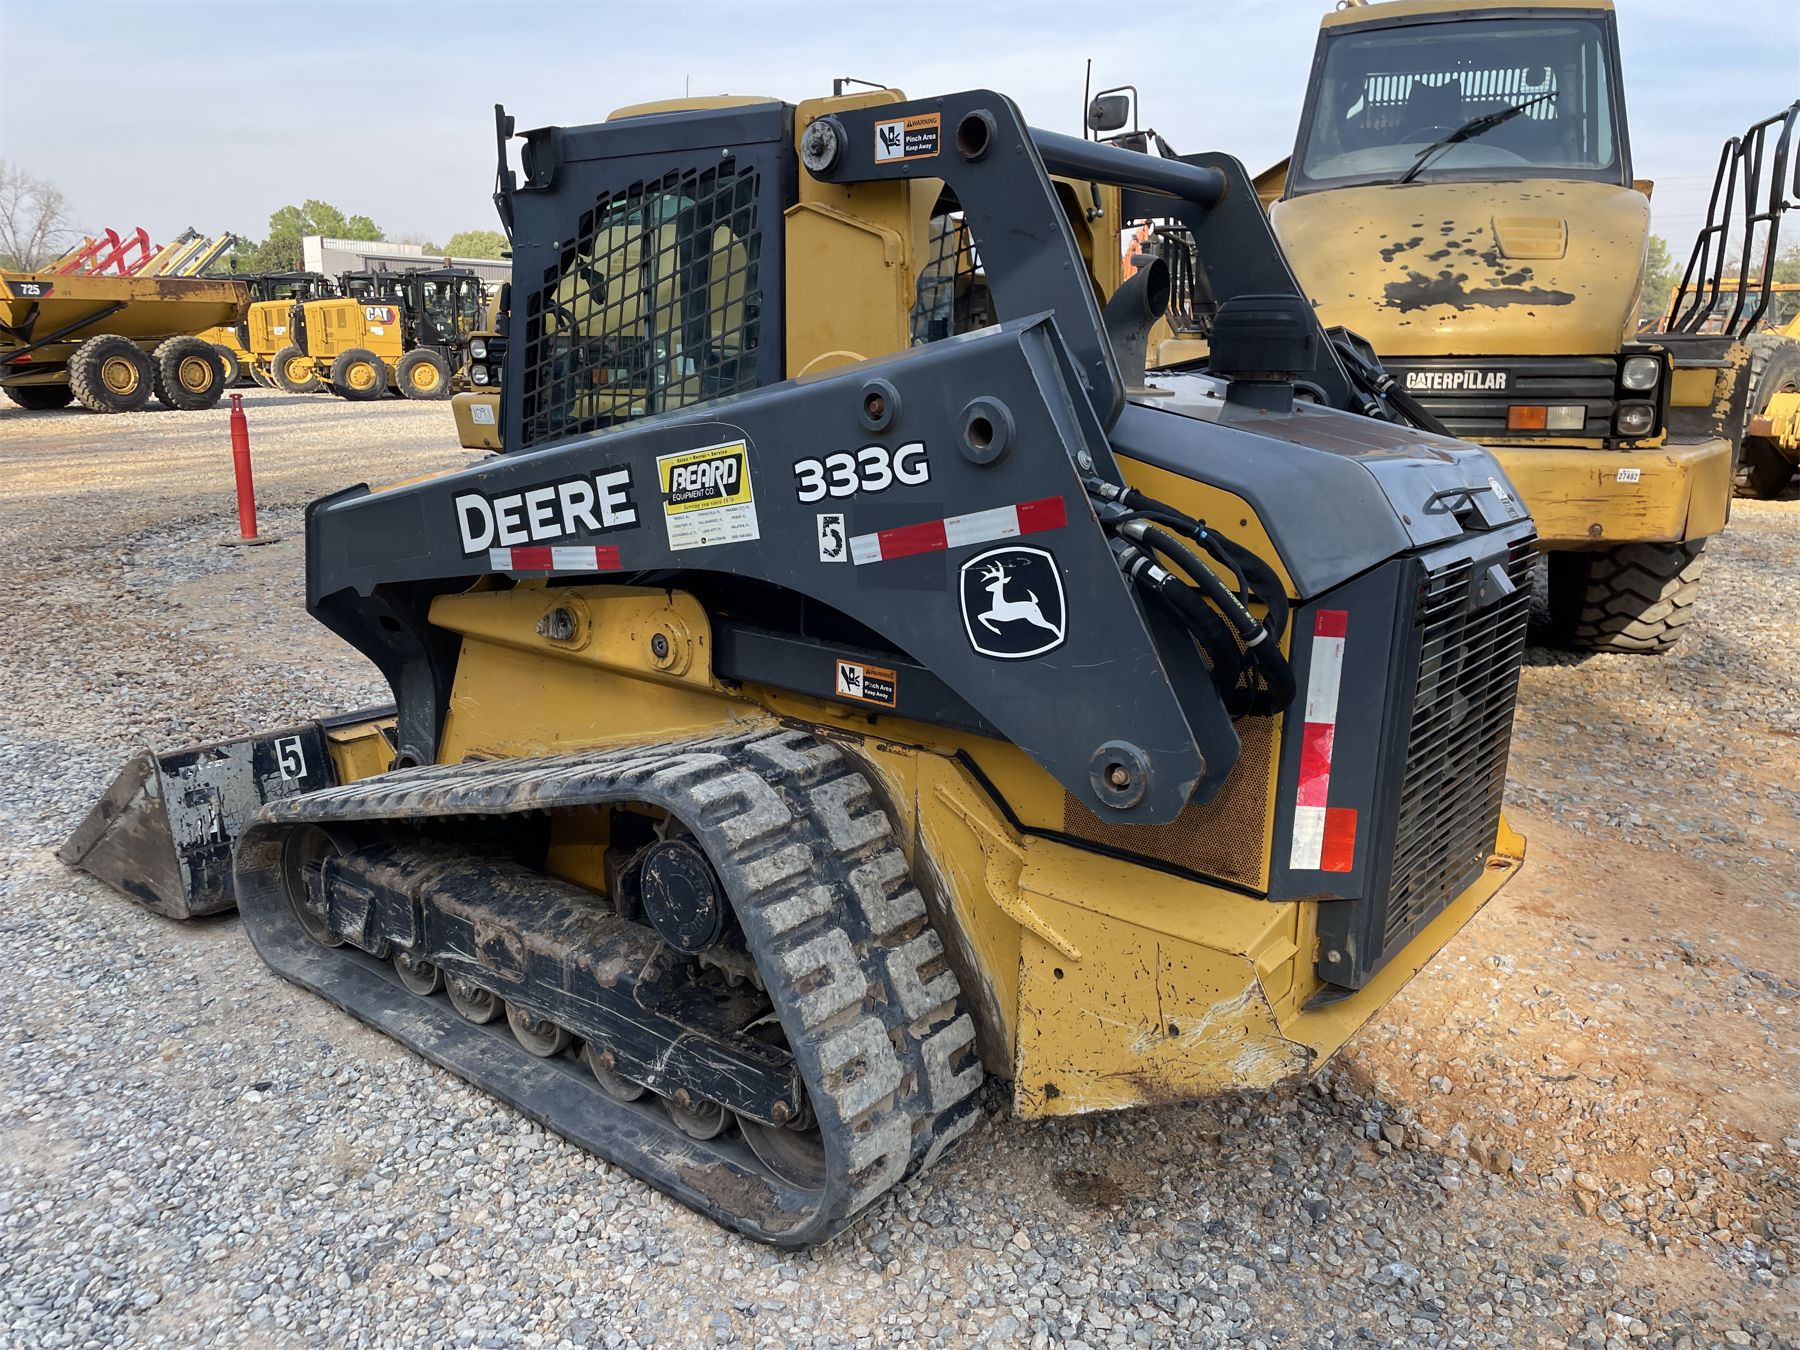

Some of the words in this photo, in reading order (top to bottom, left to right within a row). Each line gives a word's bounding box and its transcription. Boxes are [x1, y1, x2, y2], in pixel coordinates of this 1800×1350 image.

[912, 118, 937, 127] WARNING
[905, 135, 922, 143] Pinch
[922, 133, 936, 141] Area
[20, 284, 40, 295] 725
[365, 307, 389, 321] CAT
[1406, 371, 1507, 389] CATERPILLAR
[672, 458, 737, 497] BEARD
[794, 443, 929, 503] 333G
[1618, 472, 1638, 480] 27482
[672, 489, 704, 501] EQUIPMENT
[455, 470, 637, 554] DEERE
[822, 516, 843, 558] 5
[870, 670, 894, 679] WARNING
[879, 684, 893, 692] Area
[876, 691, 889, 699] Away
[279, 737, 302, 778] 5
